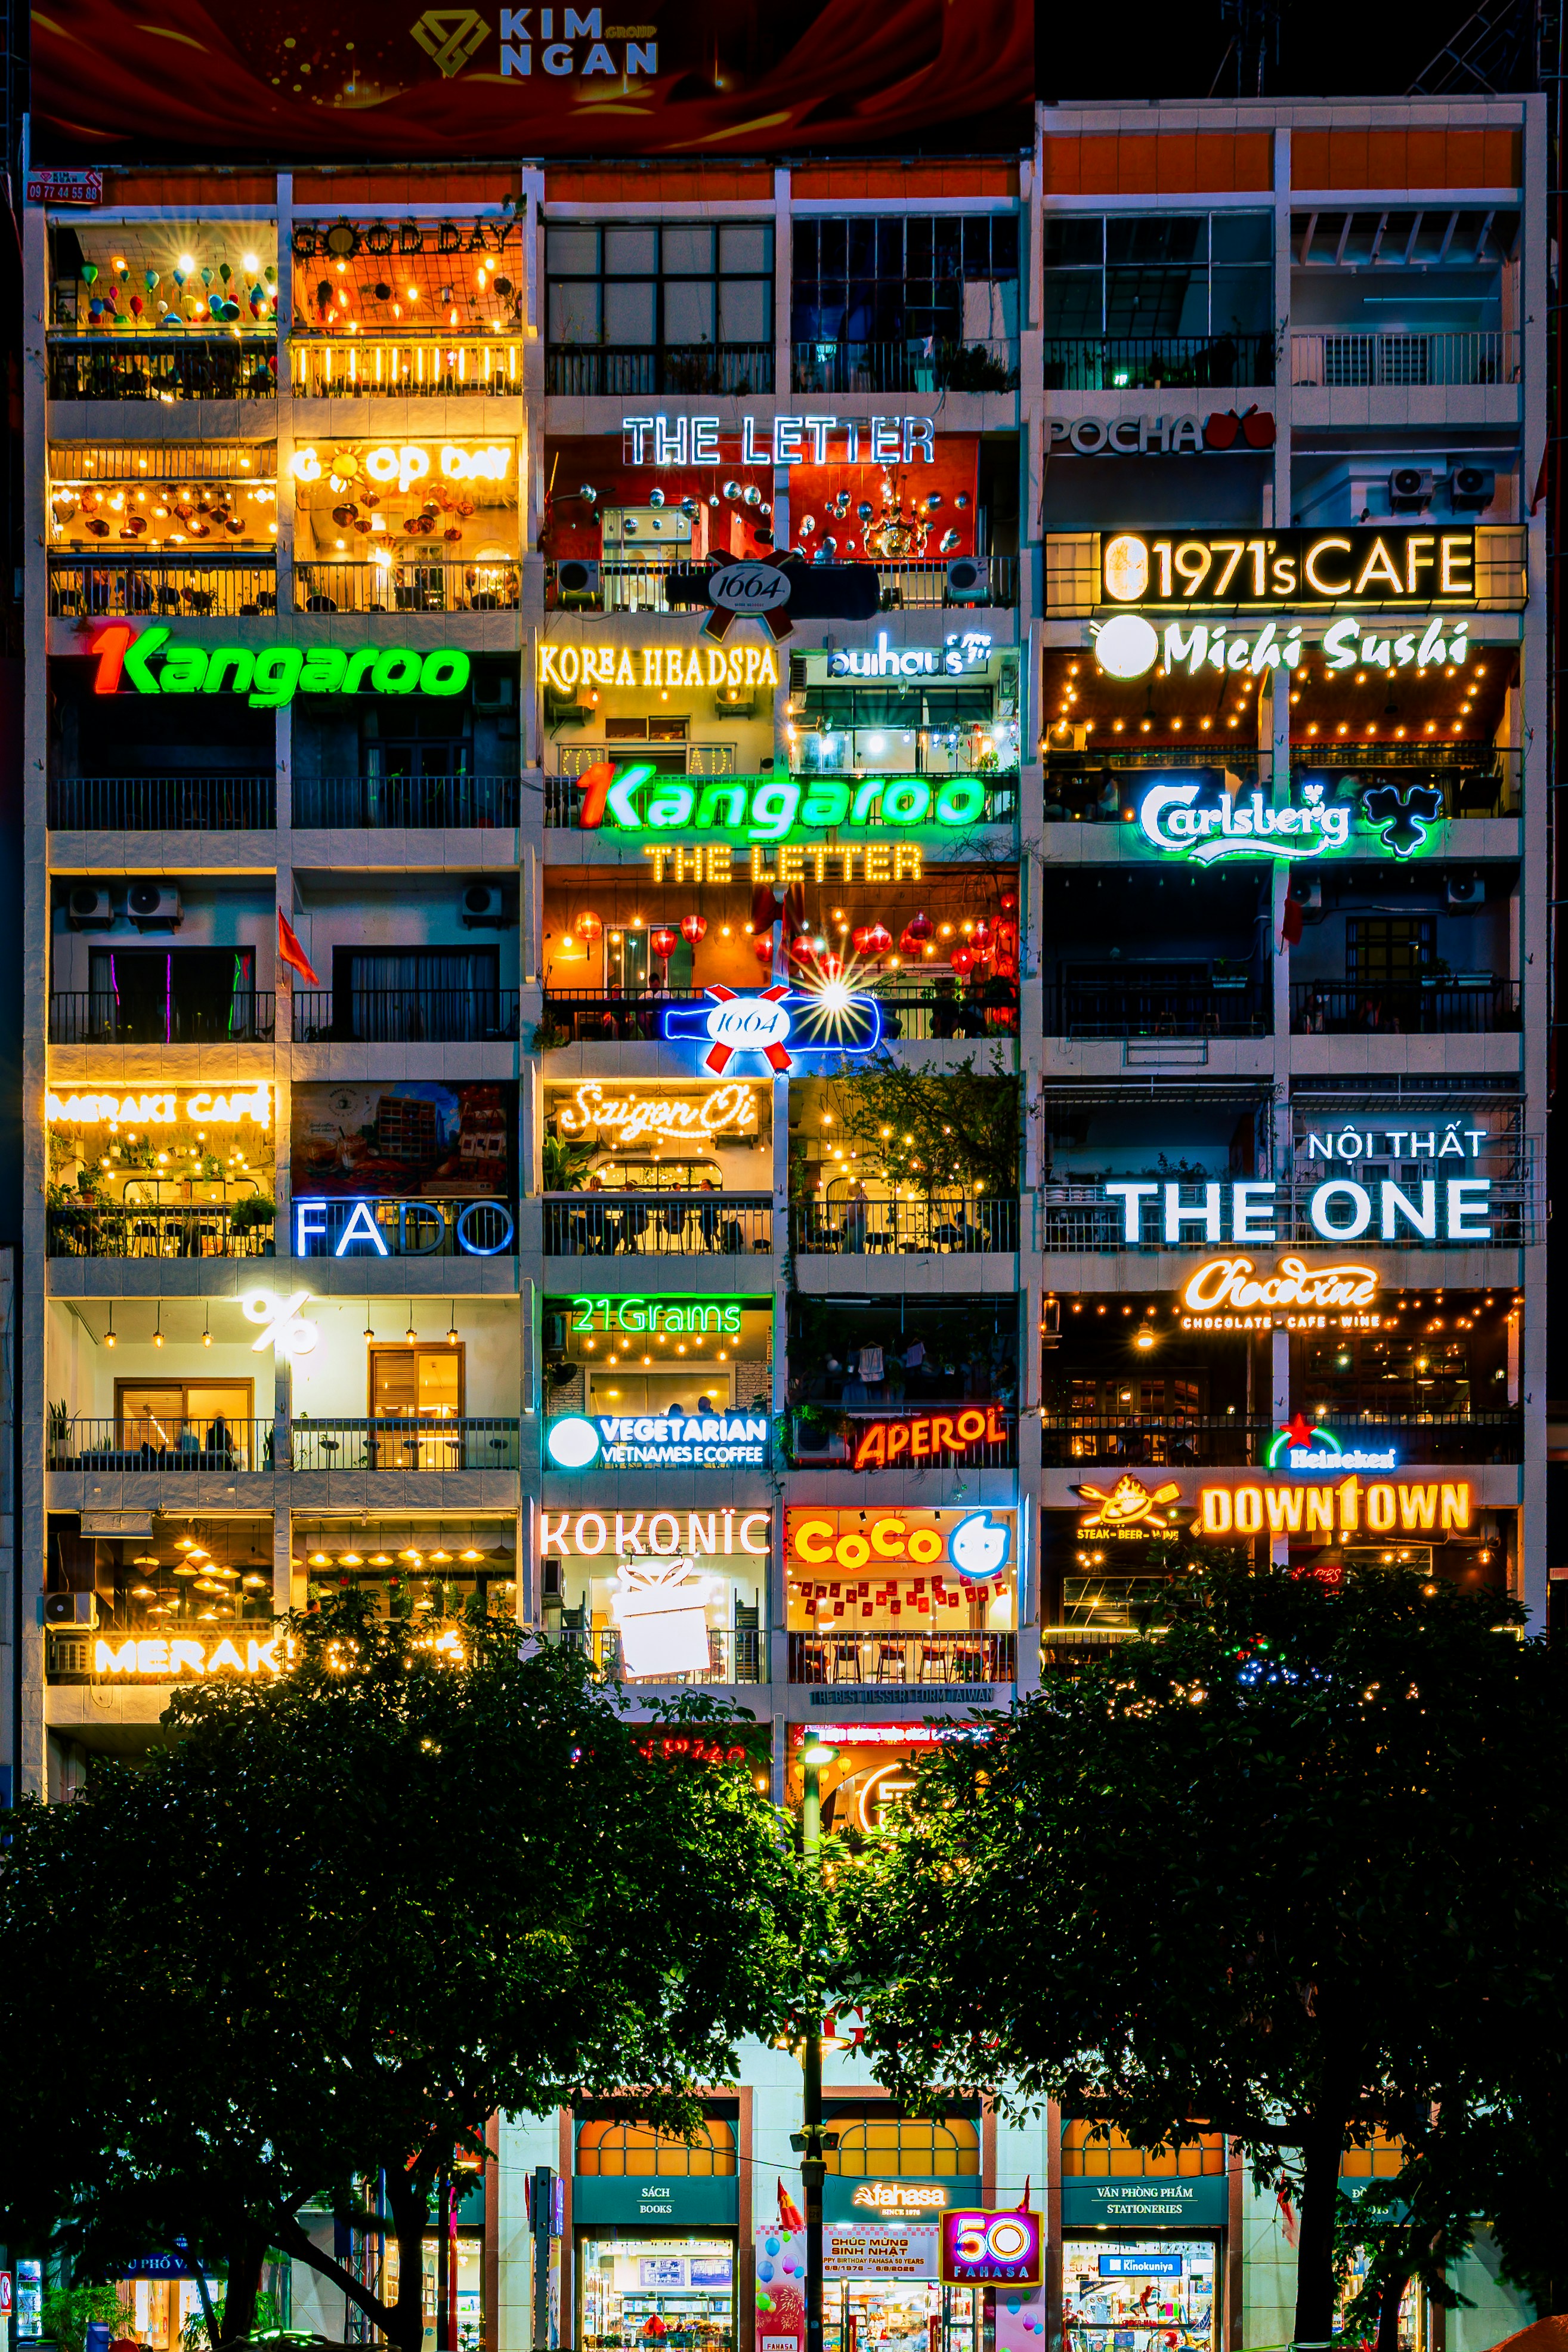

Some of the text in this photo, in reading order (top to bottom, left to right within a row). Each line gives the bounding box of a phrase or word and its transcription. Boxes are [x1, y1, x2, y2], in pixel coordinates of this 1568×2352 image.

[500, 8, 656, 39] KIM GROUP
[501, 43, 657, 75] NGAN
[30, 186, 41, 197] 09
[45, 186, 54, 197] 77
[58, 187, 69, 198] 44
[438, 222, 514, 254] DAY
[623, 416, 935, 464] THE LETTER
[1045, 415, 1204, 455] POCHA
[441, 447, 511, 480] DAY
[1152, 536, 1473, 597] 1971's CAFE
[717, 572, 785, 599] 1664
[1164, 617, 1470, 675] Michi Sushi
[539, 645, 636, 691] KOREA
[1140, 784, 1350, 849] Carlsberg
[644, 844, 923, 883] THE LETTER
[717, 1010, 779, 1034] 1664
[47, 1094, 177, 1123] MERAKI
[561, 1084, 700, 1140] Saigon
[1309, 1121, 1486, 1165] NỘI THẤT
[1106, 1179, 1491, 1243] THE ONE
[298, 1202, 514, 1256] FADO
[1183, 1316, 1380, 1328] CHOCOLATE CAFE WINE
[601, 1419, 766, 1442] VEGETARIAN
[855, 1407, 1005, 1468] APEROL
[703, 1446, 763, 1461] COFFEE
[1291, 1449, 1396, 1469] Heineken
[1077, 1529, 1109, 1539] STEAK
[1118, 1529, 1142, 1539] BEER
[812, 1688, 993, 1703] THE BEST DESSERT FORM TAIWAN
[642, 2186, 670, 2197] SÁCH
[873, 2184, 945, 2205] fahasa
[1097, 2185, 1193, 2197] VĂN PHÒNG PHẨM
[1107, 2205, 1182, 2214] STATIONERIES
[832, 2237, 908, 2246] CHÚC MỪNG
[868, 2247, 908, 2257] NHẬT
[957, 2218, 1031, 2263] 50
[141, 2255, 171, 2268] PHỐ
[954, 2266, 1029, 2277] FAHASA
[1124, 2261, 1173, 2273] Kinokuniya
